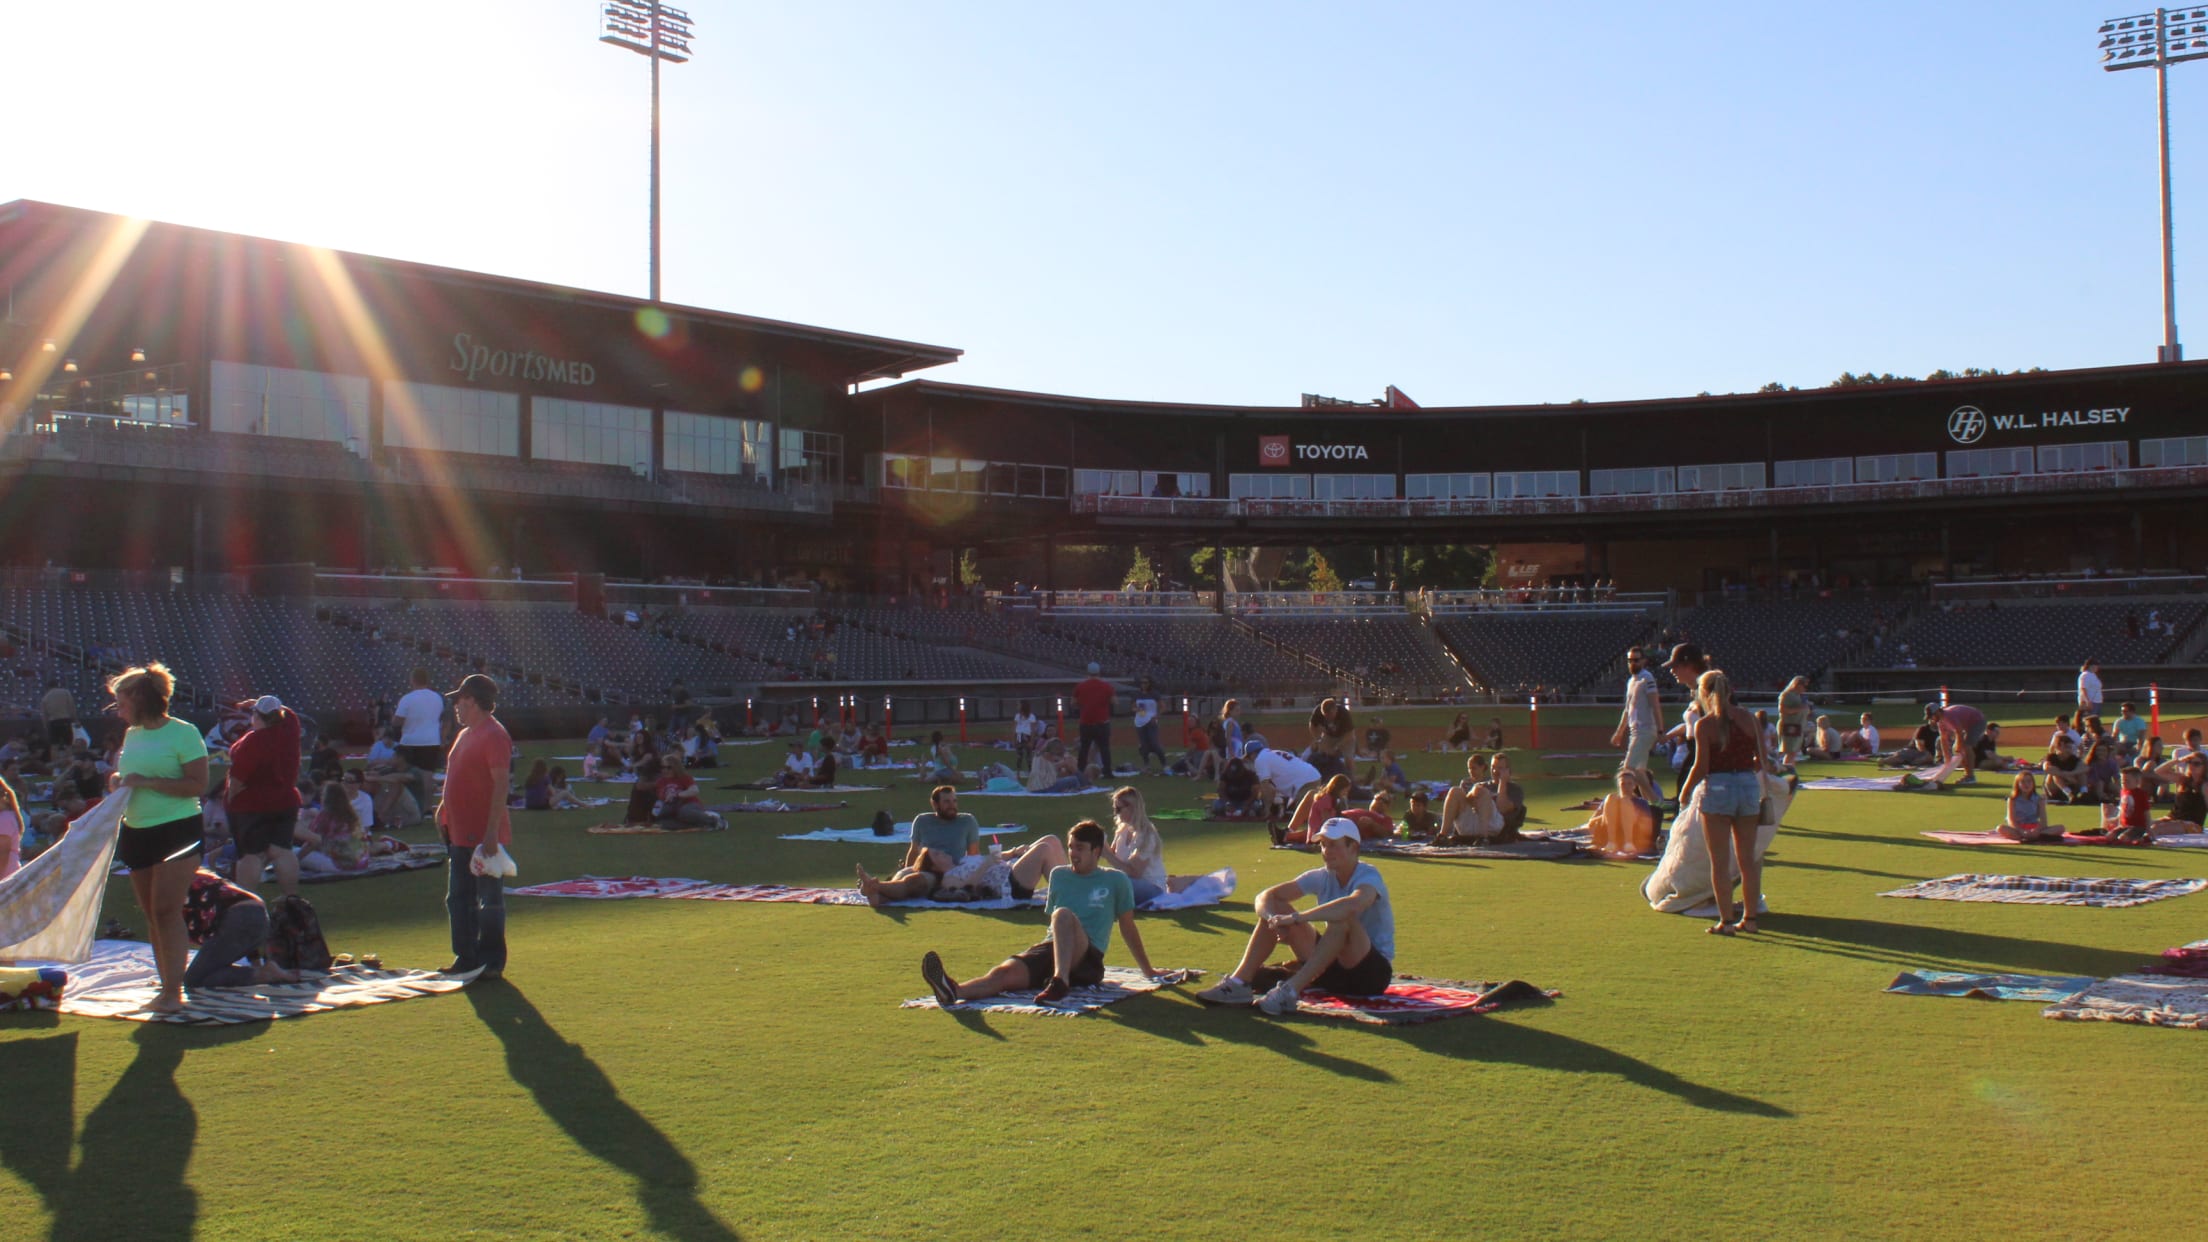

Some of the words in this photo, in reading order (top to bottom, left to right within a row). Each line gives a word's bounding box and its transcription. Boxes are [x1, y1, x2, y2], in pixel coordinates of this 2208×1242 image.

[1992, 413, 2037, 430] W.L.
[2041, 407, 2131, 428] HALSEY
[1295, 444, 1369, 460] TOYOTA
